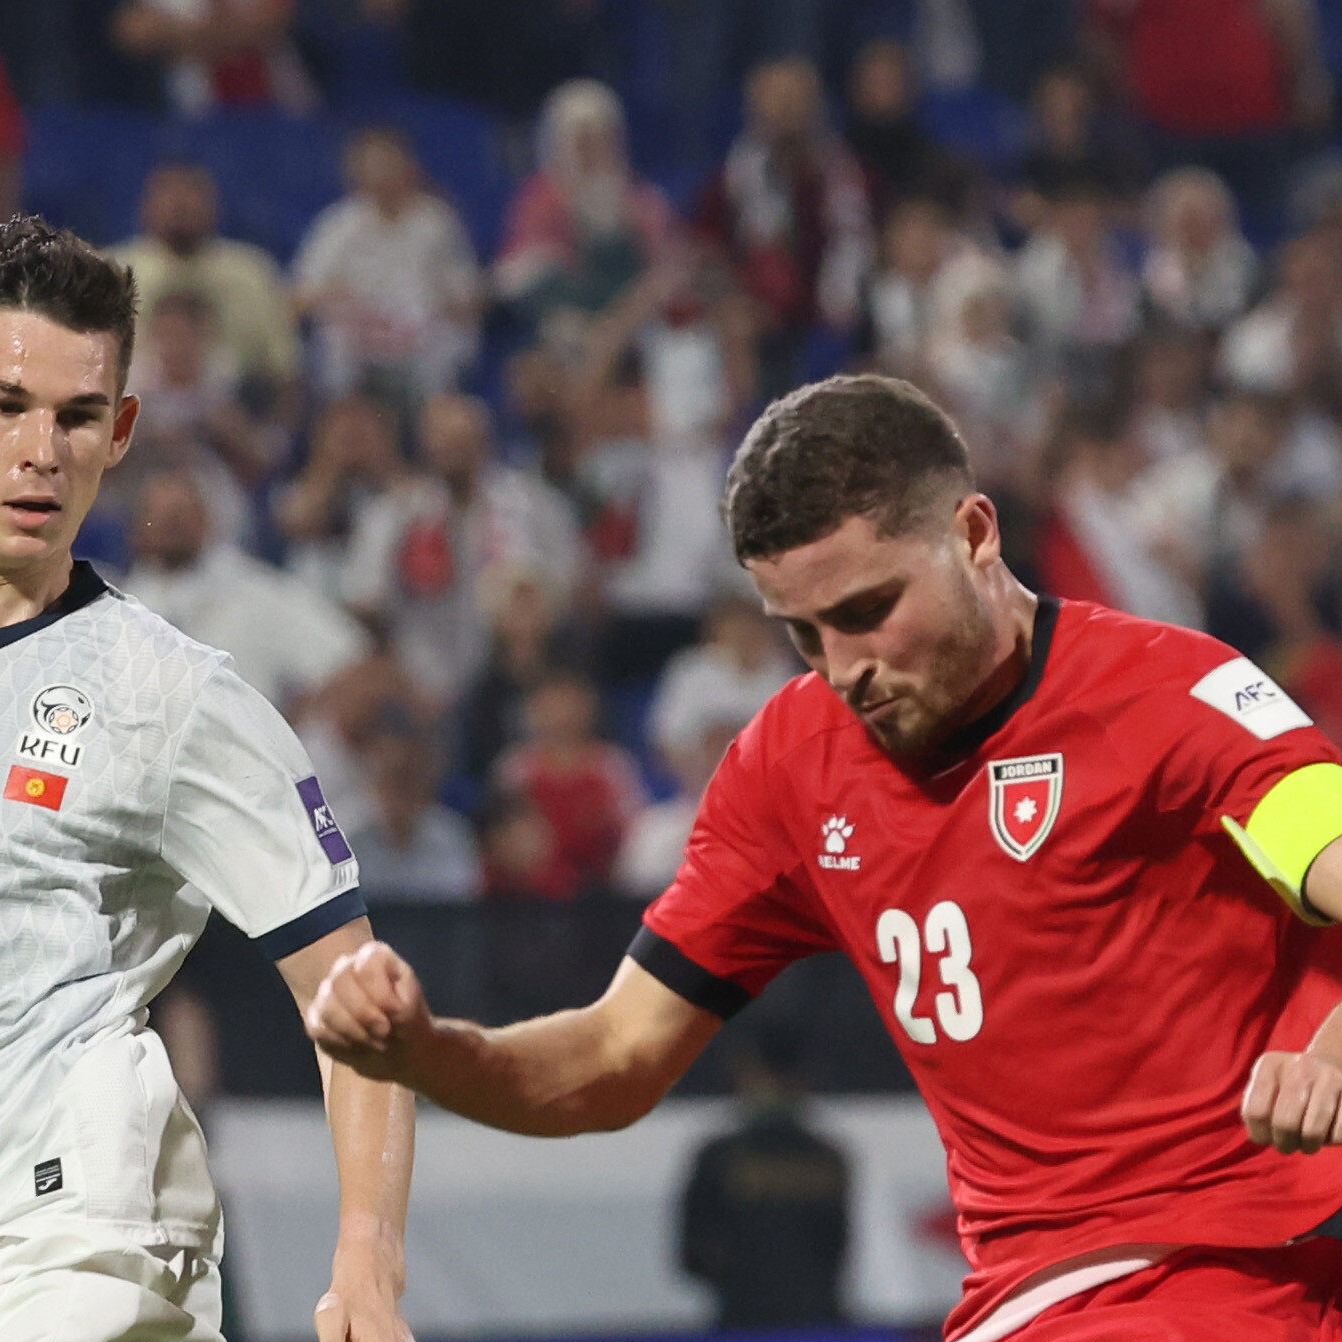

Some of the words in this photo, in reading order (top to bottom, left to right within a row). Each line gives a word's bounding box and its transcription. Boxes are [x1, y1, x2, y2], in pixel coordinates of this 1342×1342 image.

[1235, 681, 1275, 711] AFC
[20, 735, 80, 766] KFU
[1001, 760, 1053, 779] JORDAN
[875, 900, 985, 1045] 23
